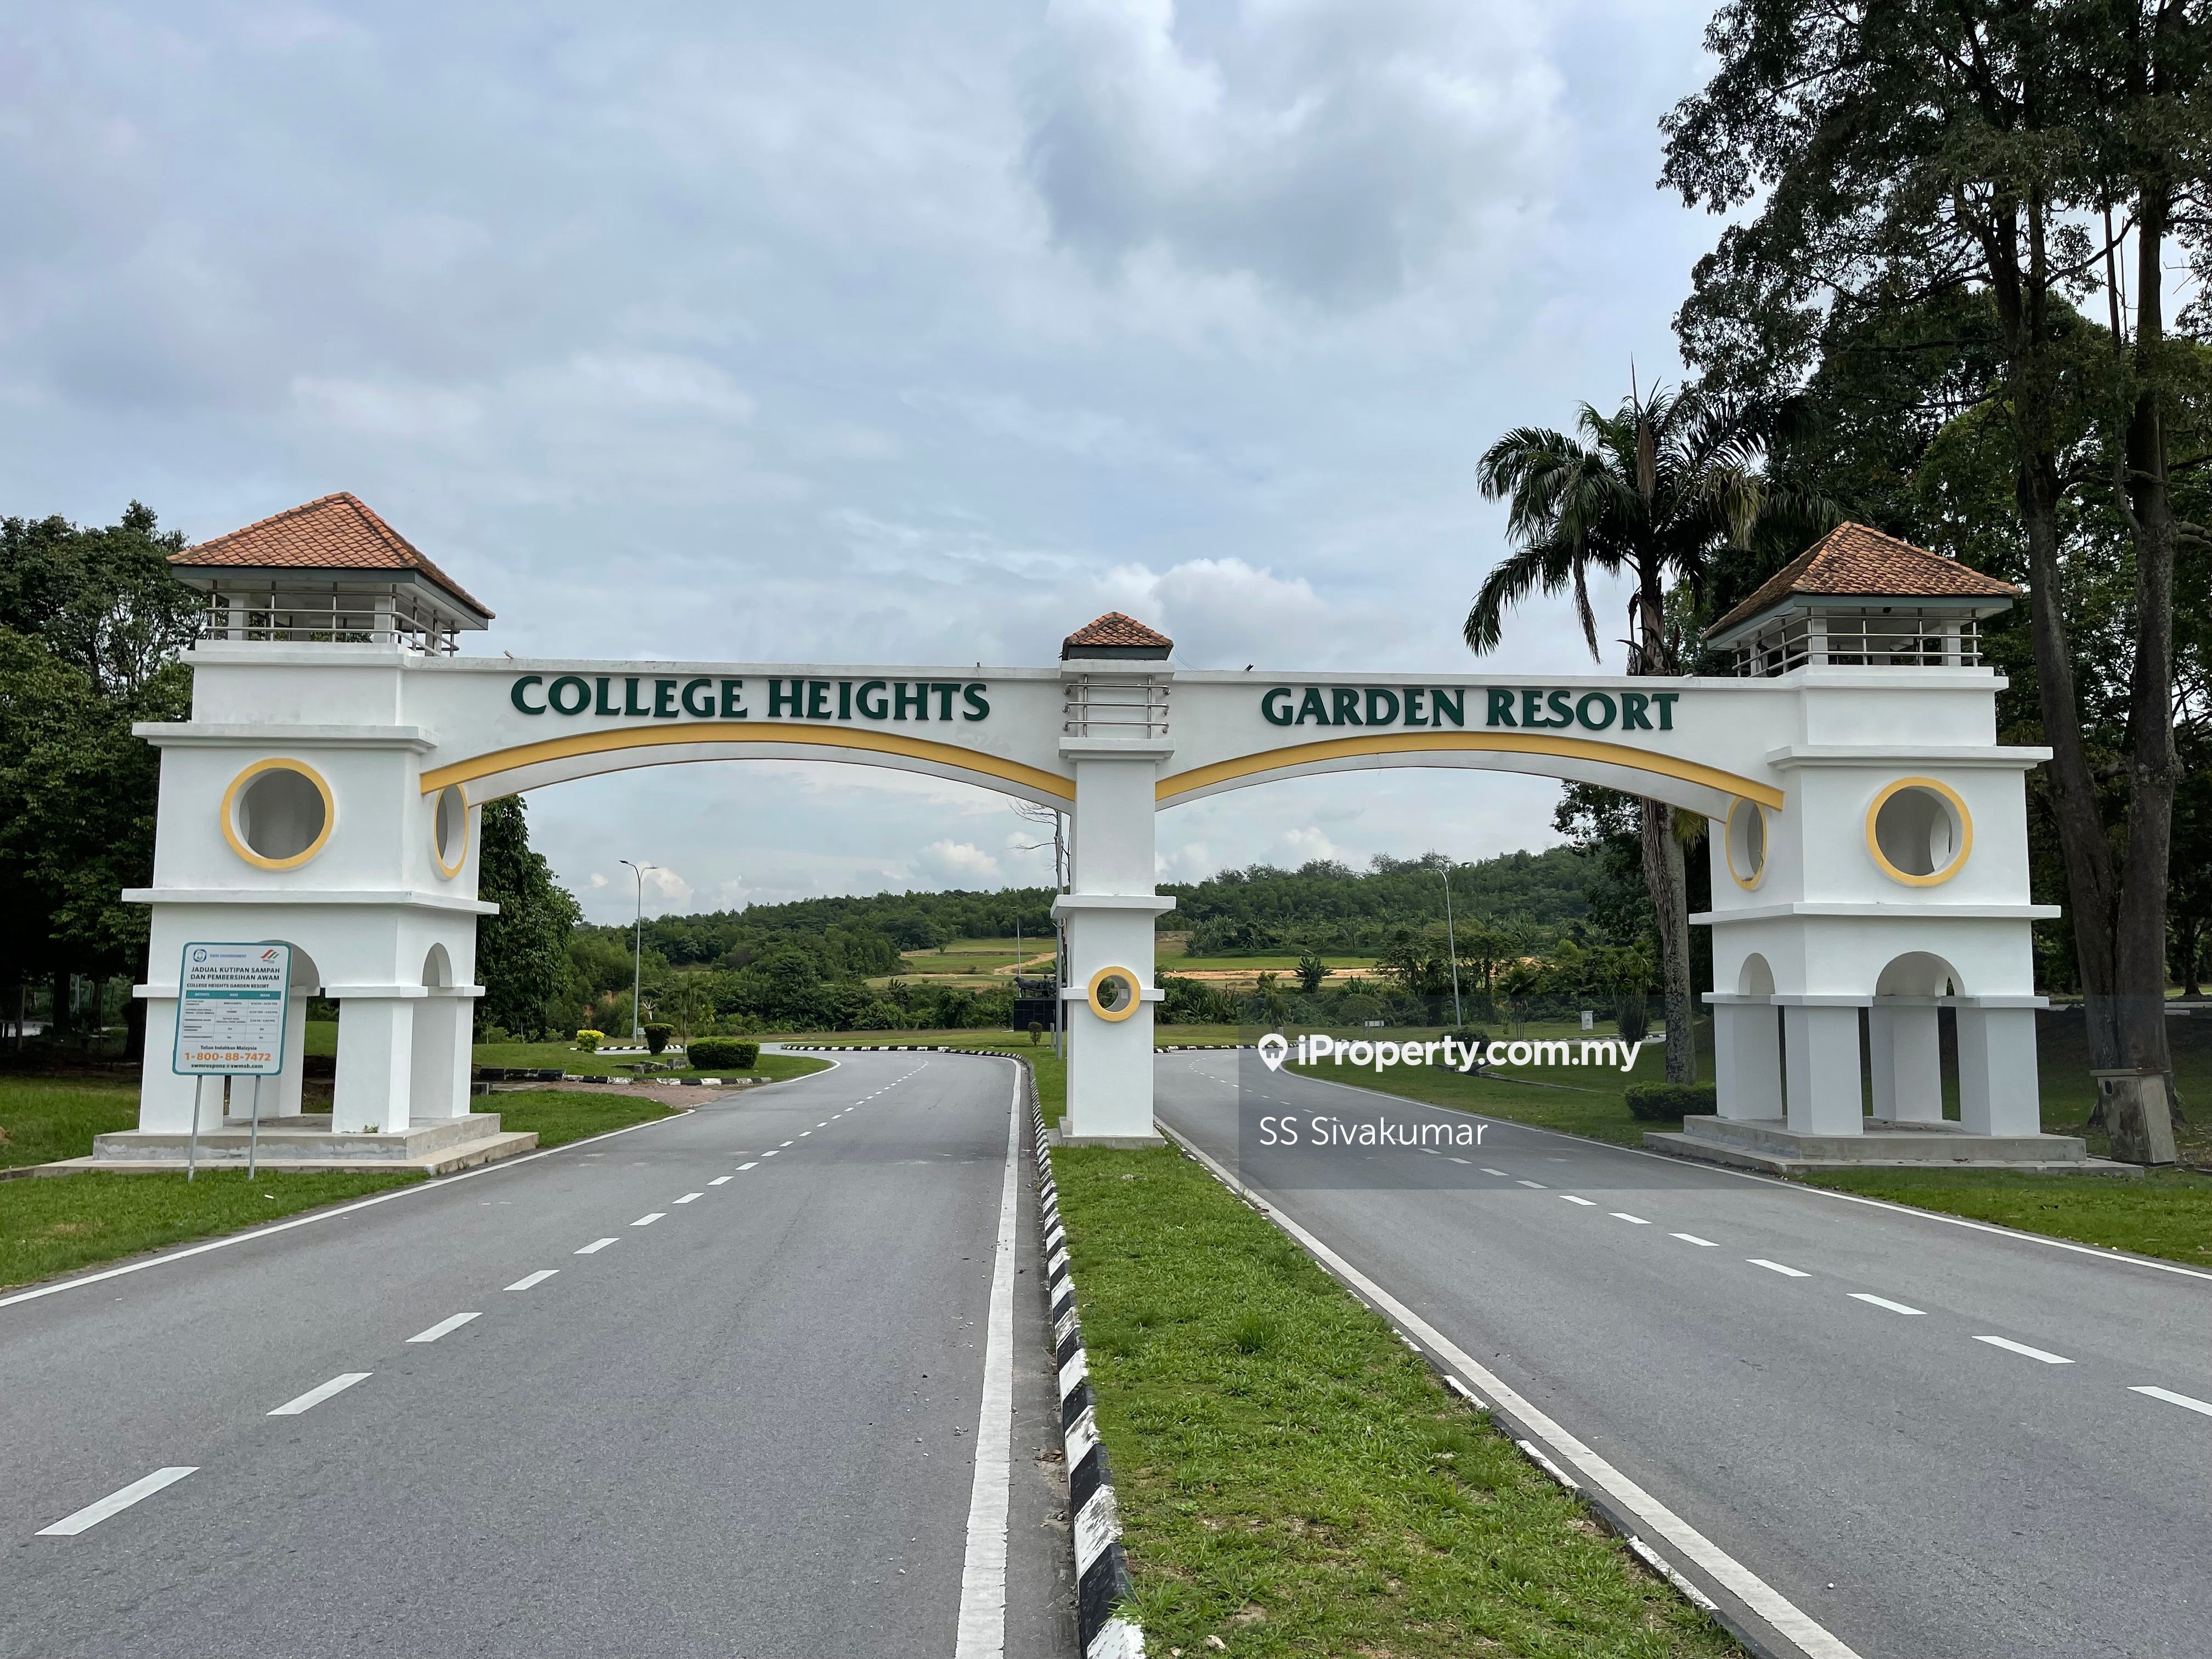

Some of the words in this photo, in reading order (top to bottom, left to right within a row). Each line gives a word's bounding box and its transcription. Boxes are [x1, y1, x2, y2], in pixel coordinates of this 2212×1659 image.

[511, 675, 748, 718] COLLEGE
[768, 679, 990, 721] HEIGHTS
[1261, 687, 1465, 726] GARDEN
[1486, 689, 1679, 730] RESORT
[185, 1052, 271, 1061] 1-800-88-7472
